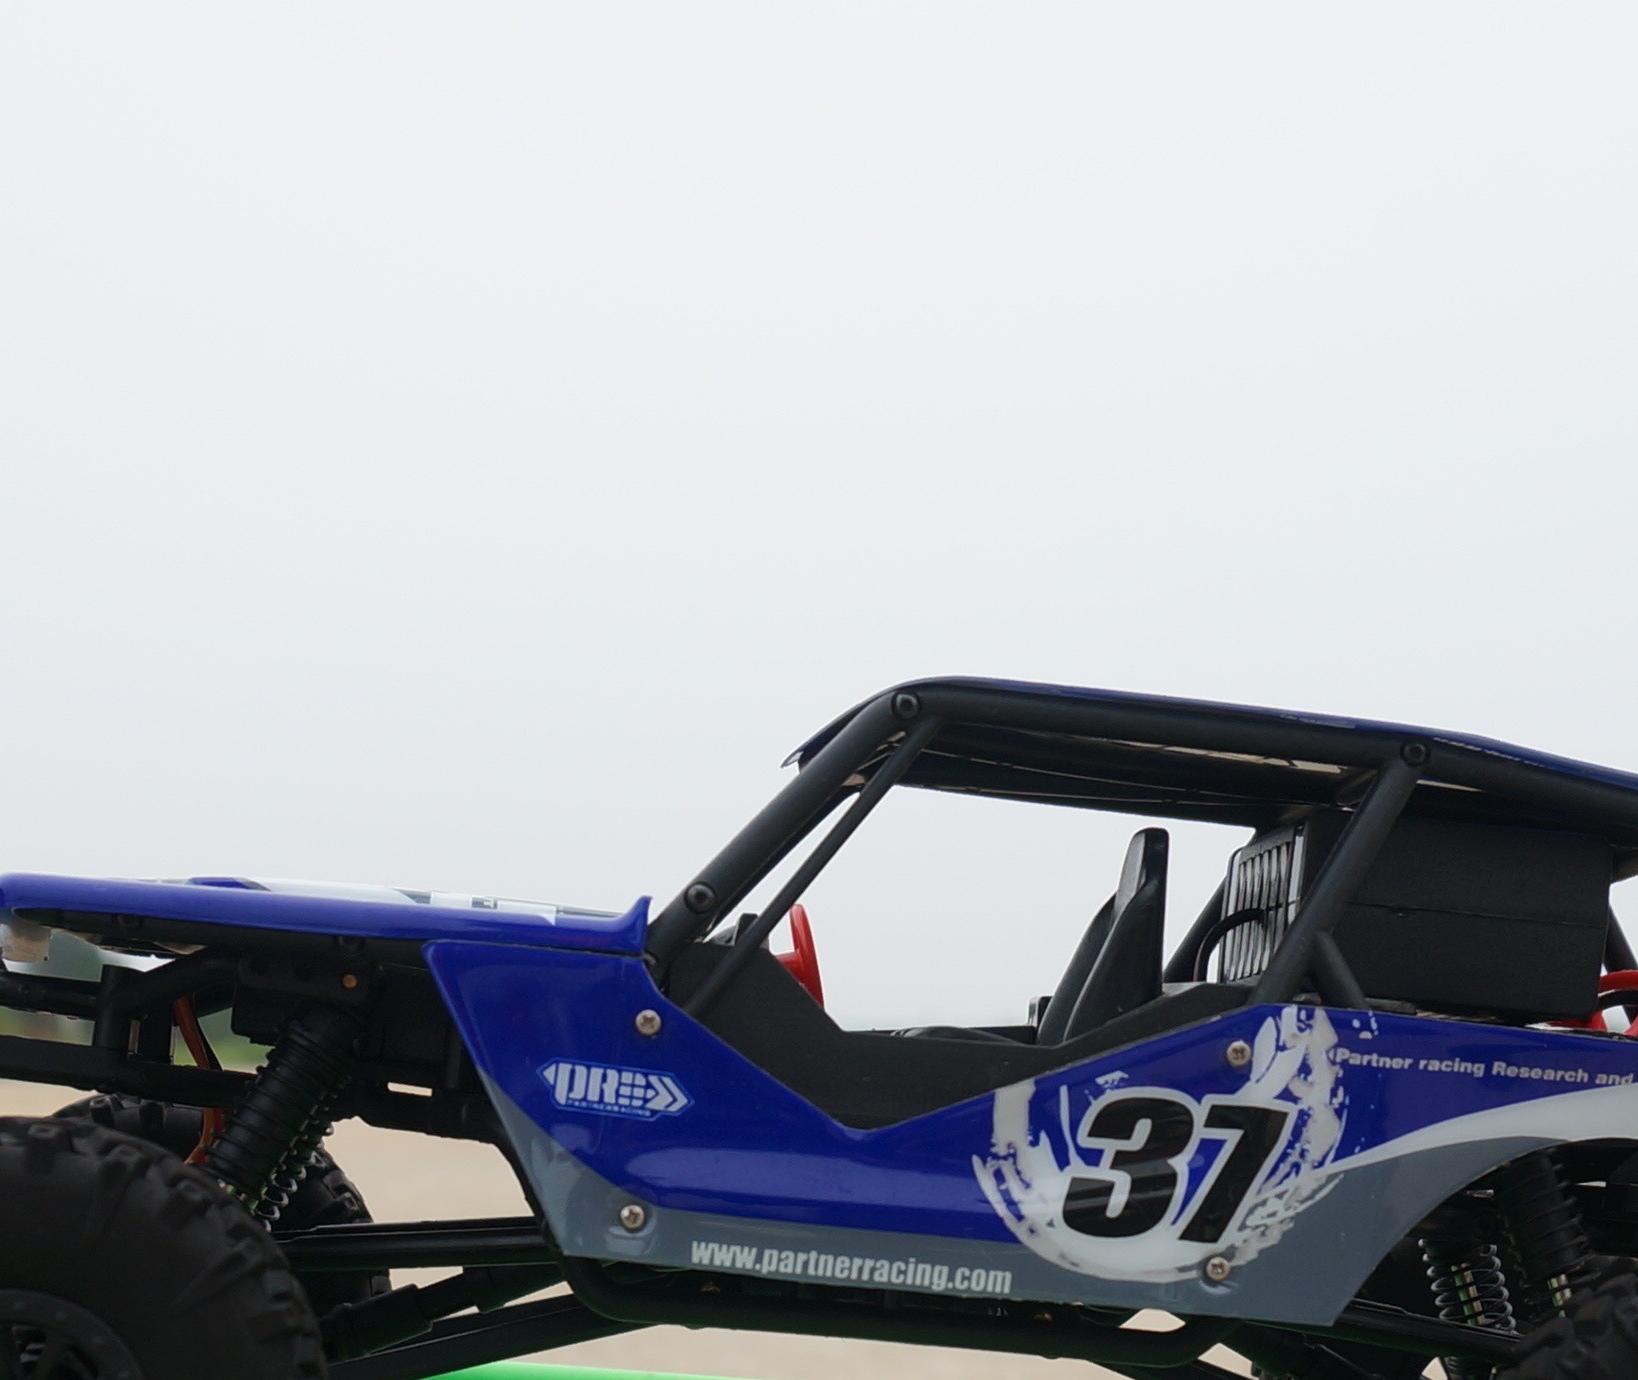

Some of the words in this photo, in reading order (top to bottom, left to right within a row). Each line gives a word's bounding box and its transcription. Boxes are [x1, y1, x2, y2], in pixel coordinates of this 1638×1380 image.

[1335, 1048, 1413, 1070] Partner
[1419, 1058, 1485, 1078] racing
[1491, 1060, 1589, 1083] Research
[1595, 1072, 1634, 1087] and
[1061, 1097, 1290, 1244] 37
[690, 1240, 1012, 1295] www.partnerracing.com
